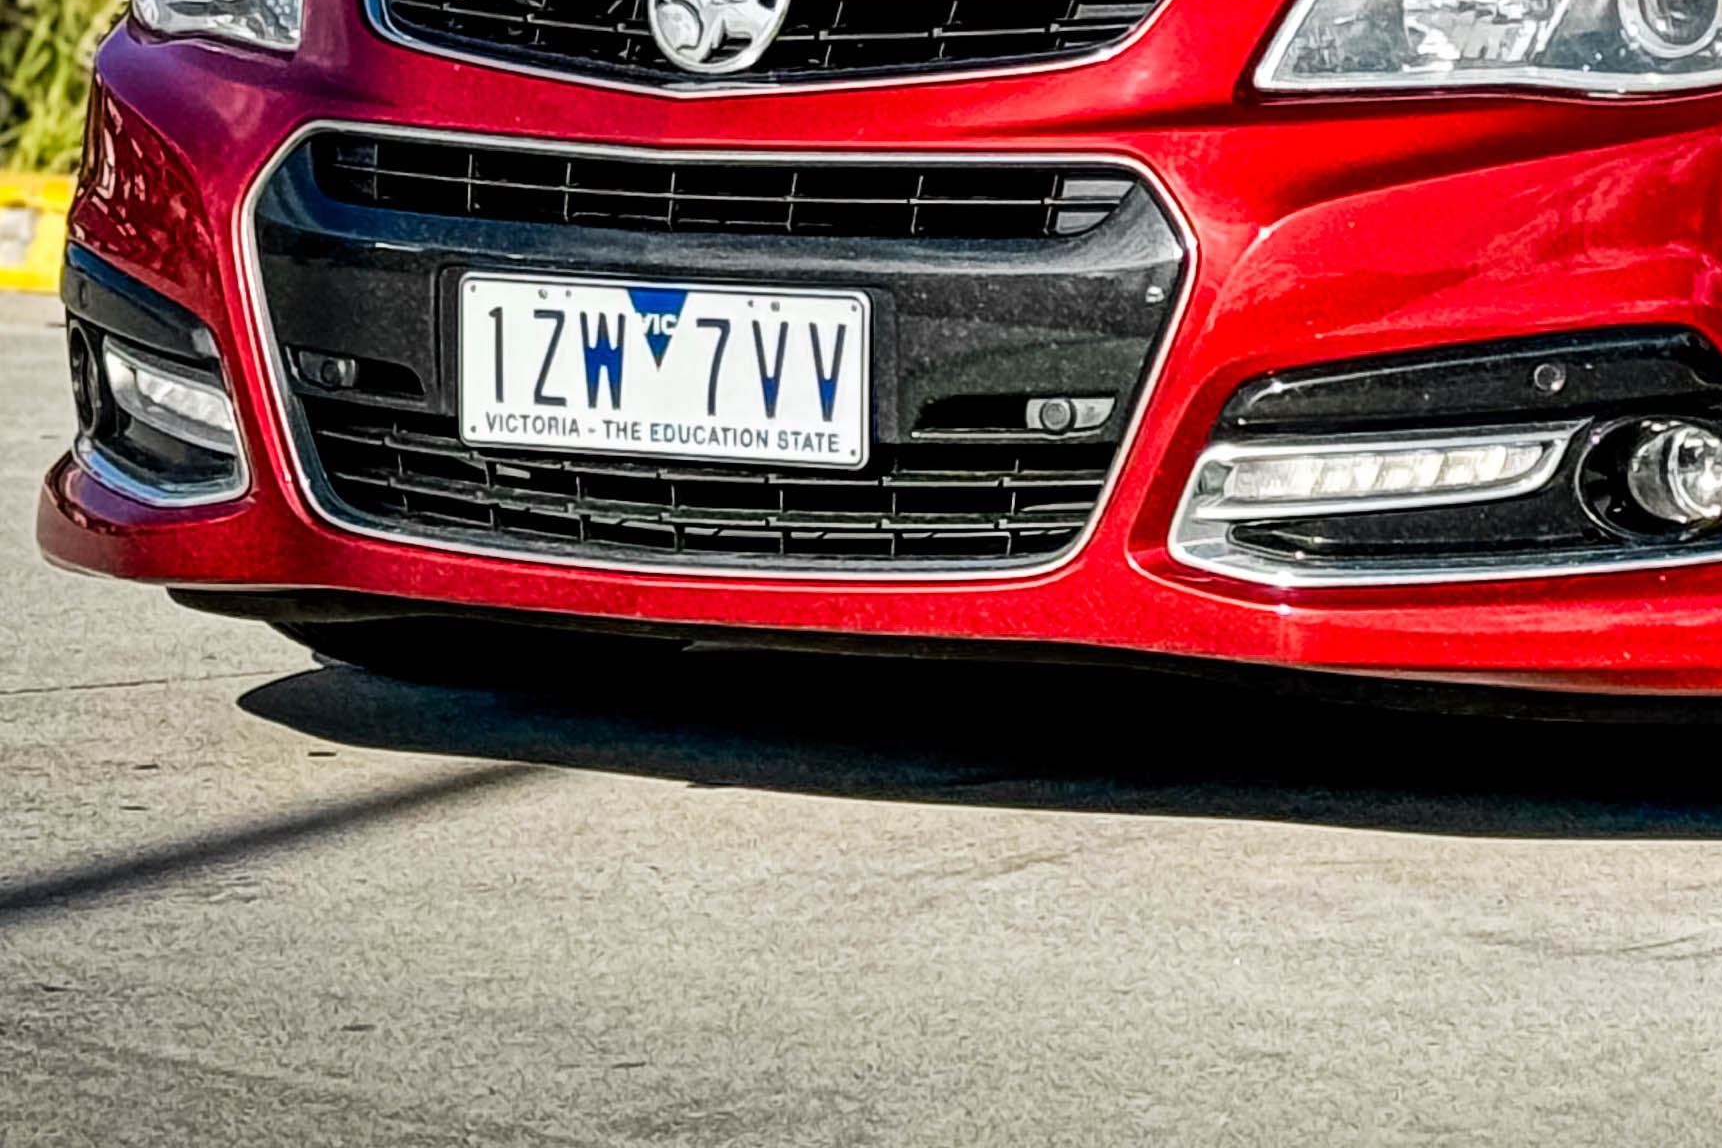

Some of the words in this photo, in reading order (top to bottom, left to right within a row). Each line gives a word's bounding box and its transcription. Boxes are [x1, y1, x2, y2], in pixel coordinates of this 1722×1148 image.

[638, 313, 680, 336] VIC
[488, 306, 627, 410] 1ZW
[696, 318, 847, 422] 7VV
[485, 411, 581, 438] VICTORIA
[603, 419, 642, 442] THE
[649, 422, 769, 449] EDUCATION
[777, 430, 841, 454] STATE
